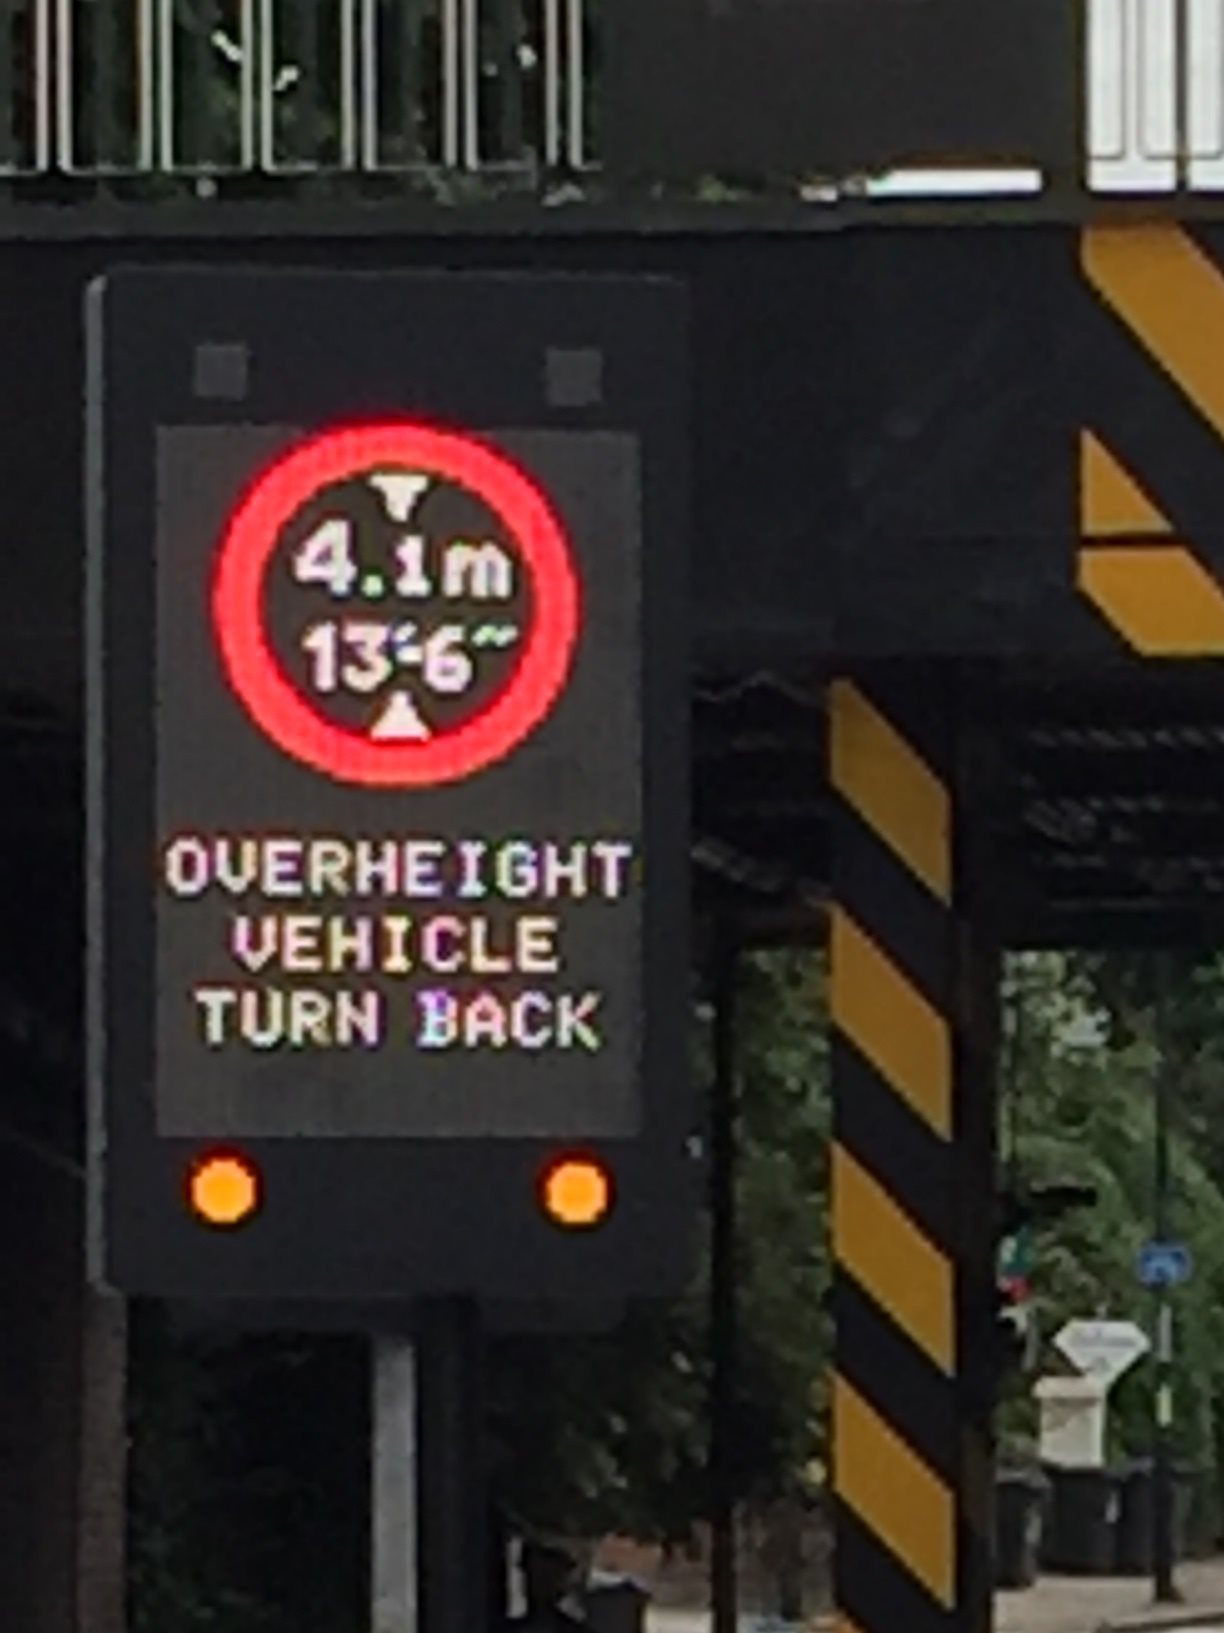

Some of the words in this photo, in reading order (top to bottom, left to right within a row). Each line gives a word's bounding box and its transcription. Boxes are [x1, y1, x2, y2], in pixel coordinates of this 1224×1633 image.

[293, 519, 512, 598] 4.1m
[165, 838, 632, 897] OVERHEIGHT
[234, 914, 559, 973] VEHICLE
[194, 987, 378, 1047] TURN
[417, 989, 601, 1050] BACK
